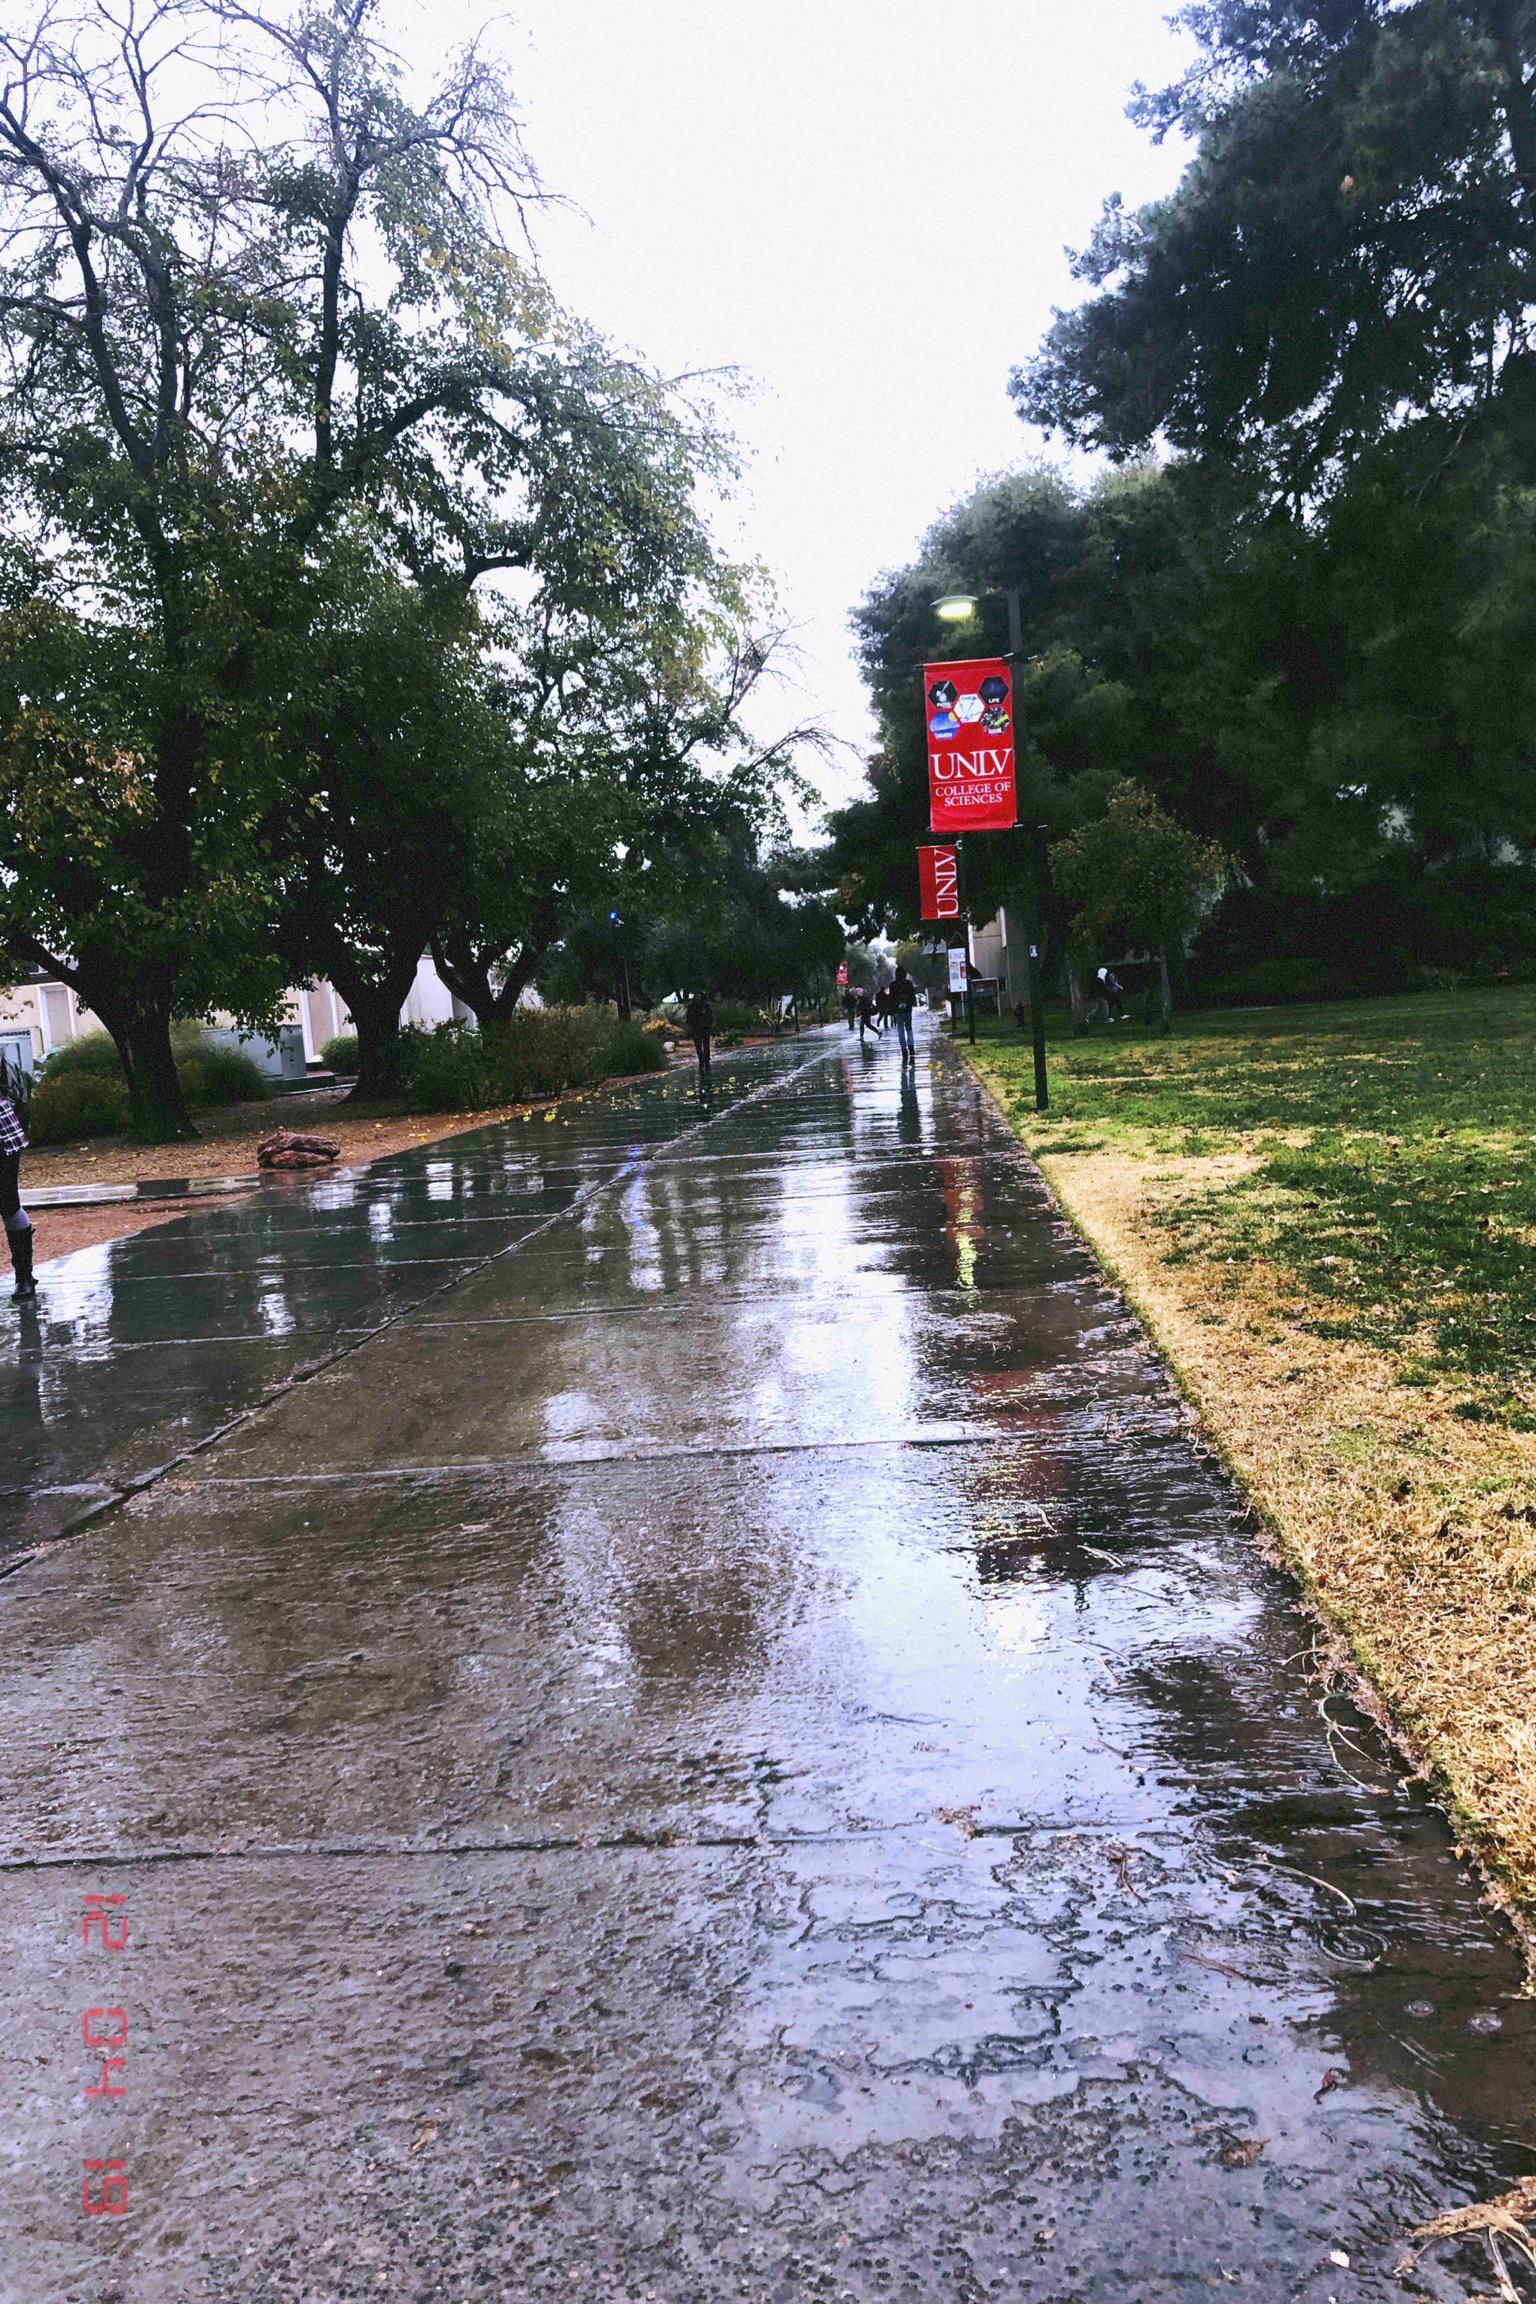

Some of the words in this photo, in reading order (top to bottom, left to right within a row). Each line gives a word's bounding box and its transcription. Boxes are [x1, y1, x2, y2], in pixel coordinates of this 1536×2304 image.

[930, 748, 1012, 779] UNLV
[935, 783, 991, 797] COLLEGE
[994, 781, 1011, 792] OF
[944, 793, 1003, 807] SCIENCES
[934, 848, 958, 919] UNLV
